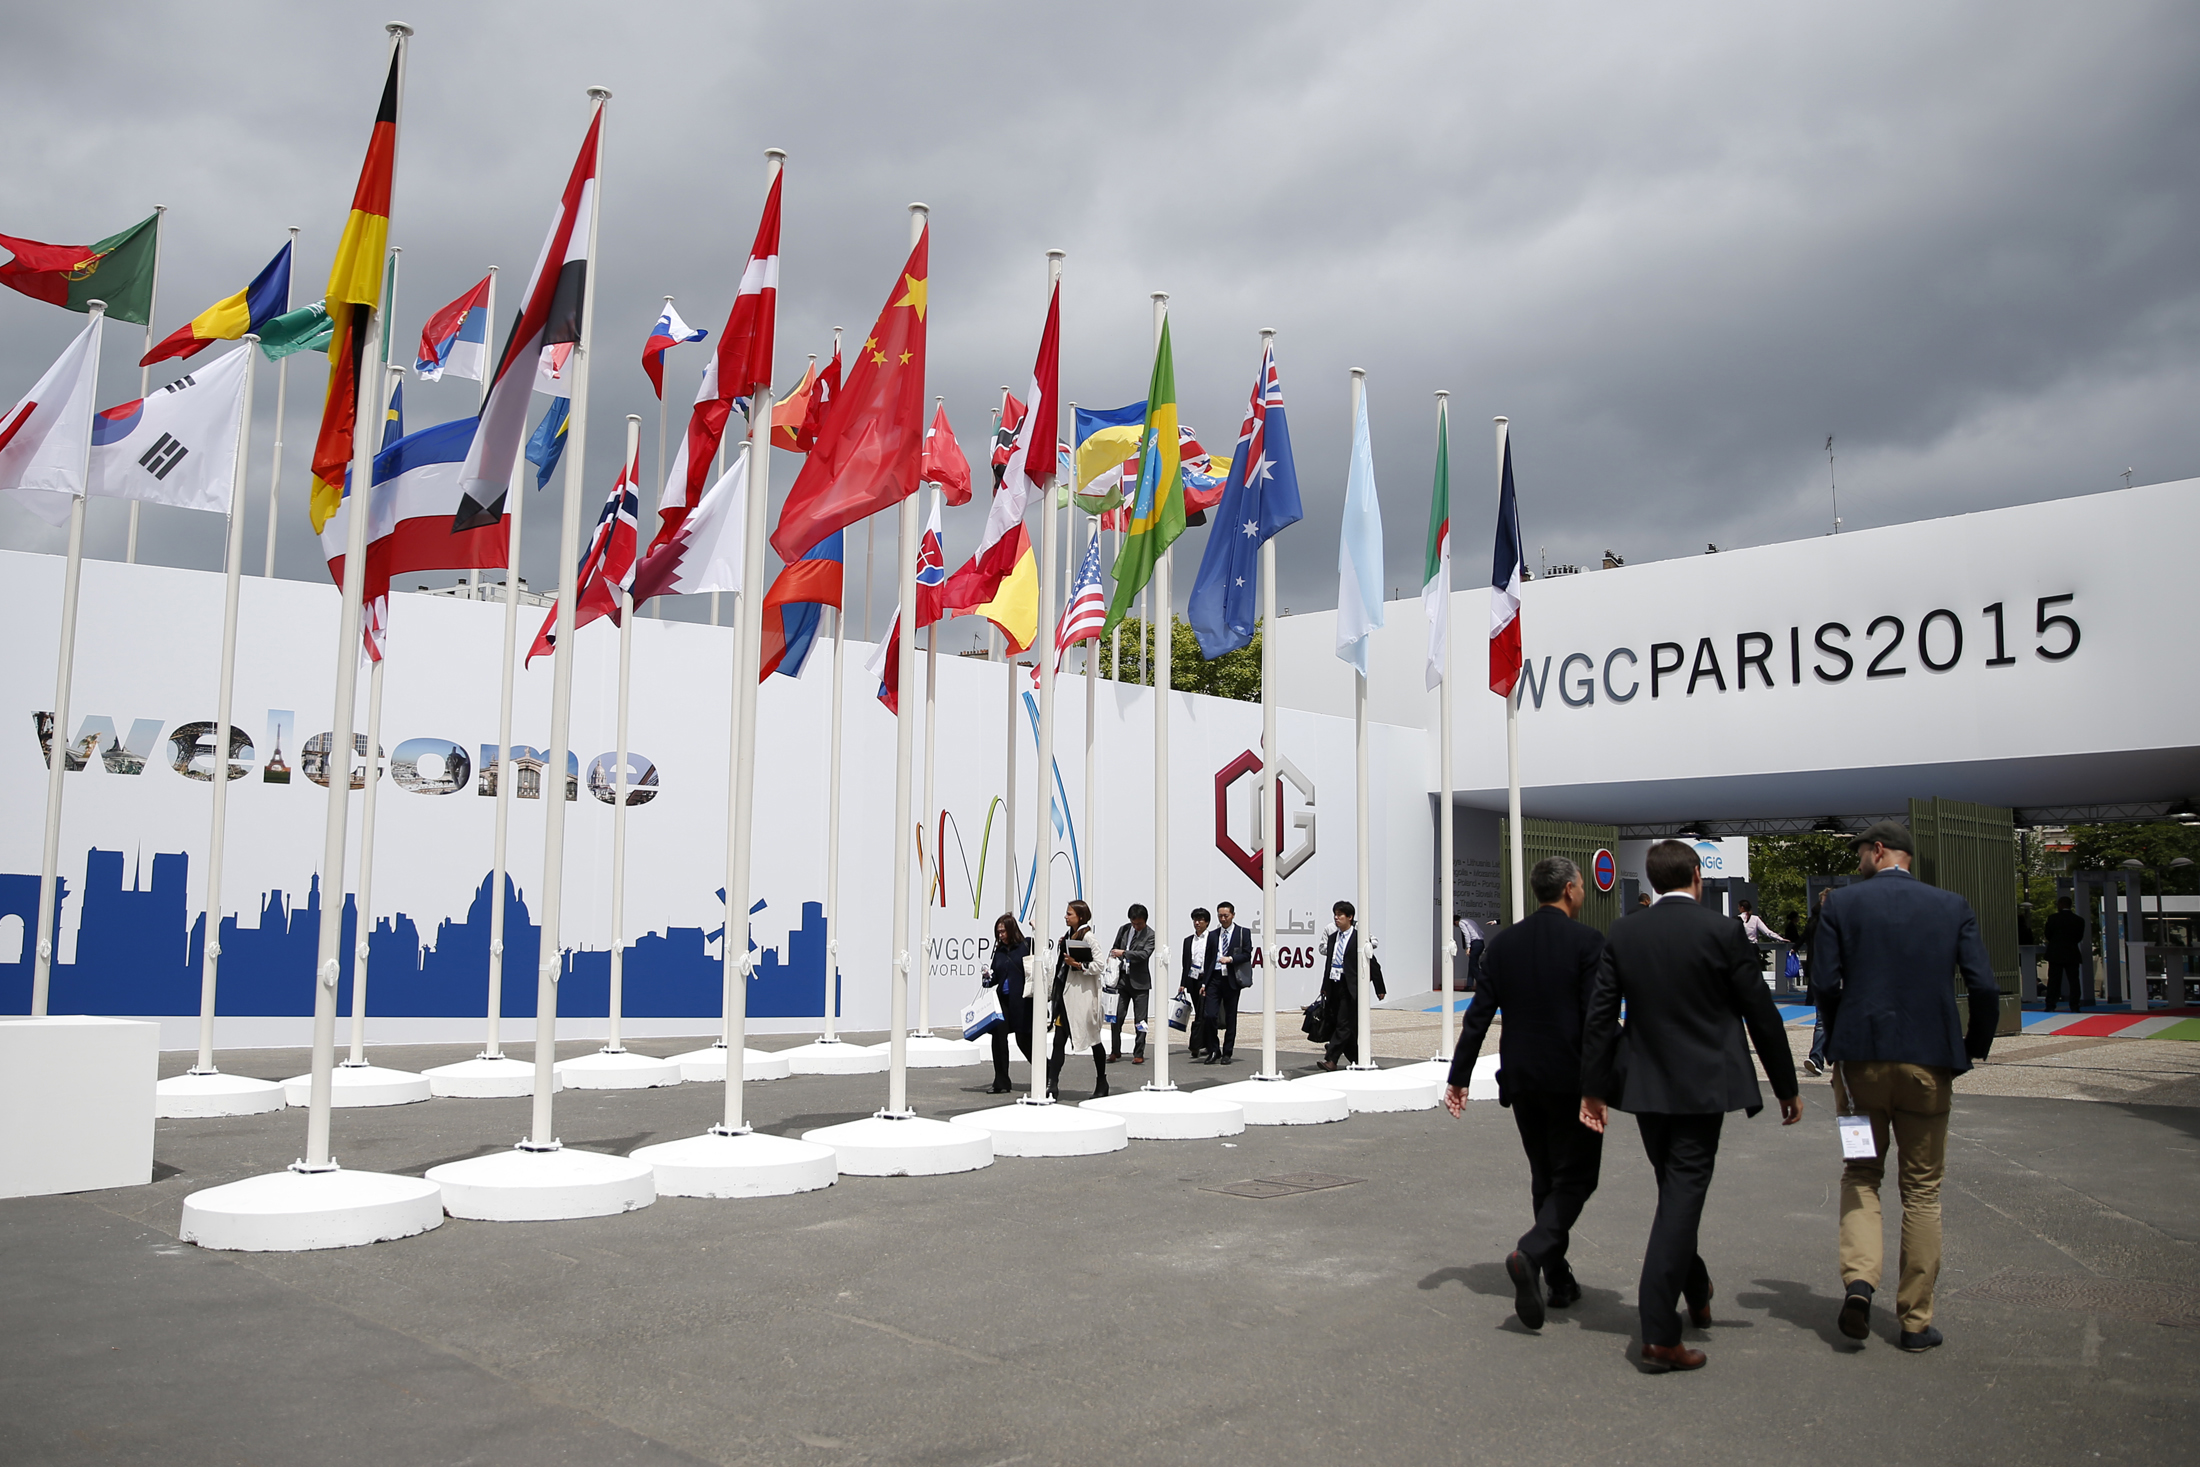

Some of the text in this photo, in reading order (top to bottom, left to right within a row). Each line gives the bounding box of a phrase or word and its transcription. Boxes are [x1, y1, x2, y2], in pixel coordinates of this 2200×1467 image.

[1516, 592, 2082, 711] WGCPARIS2015
[30, 708, 661, 807] welcome
[1482, 880, 1500, 890] Portug
[1487, 900, 1501, 909] Timo
[1486, 910, 1500, 918] Unite
[929, 964, 975, 976] WORLD
